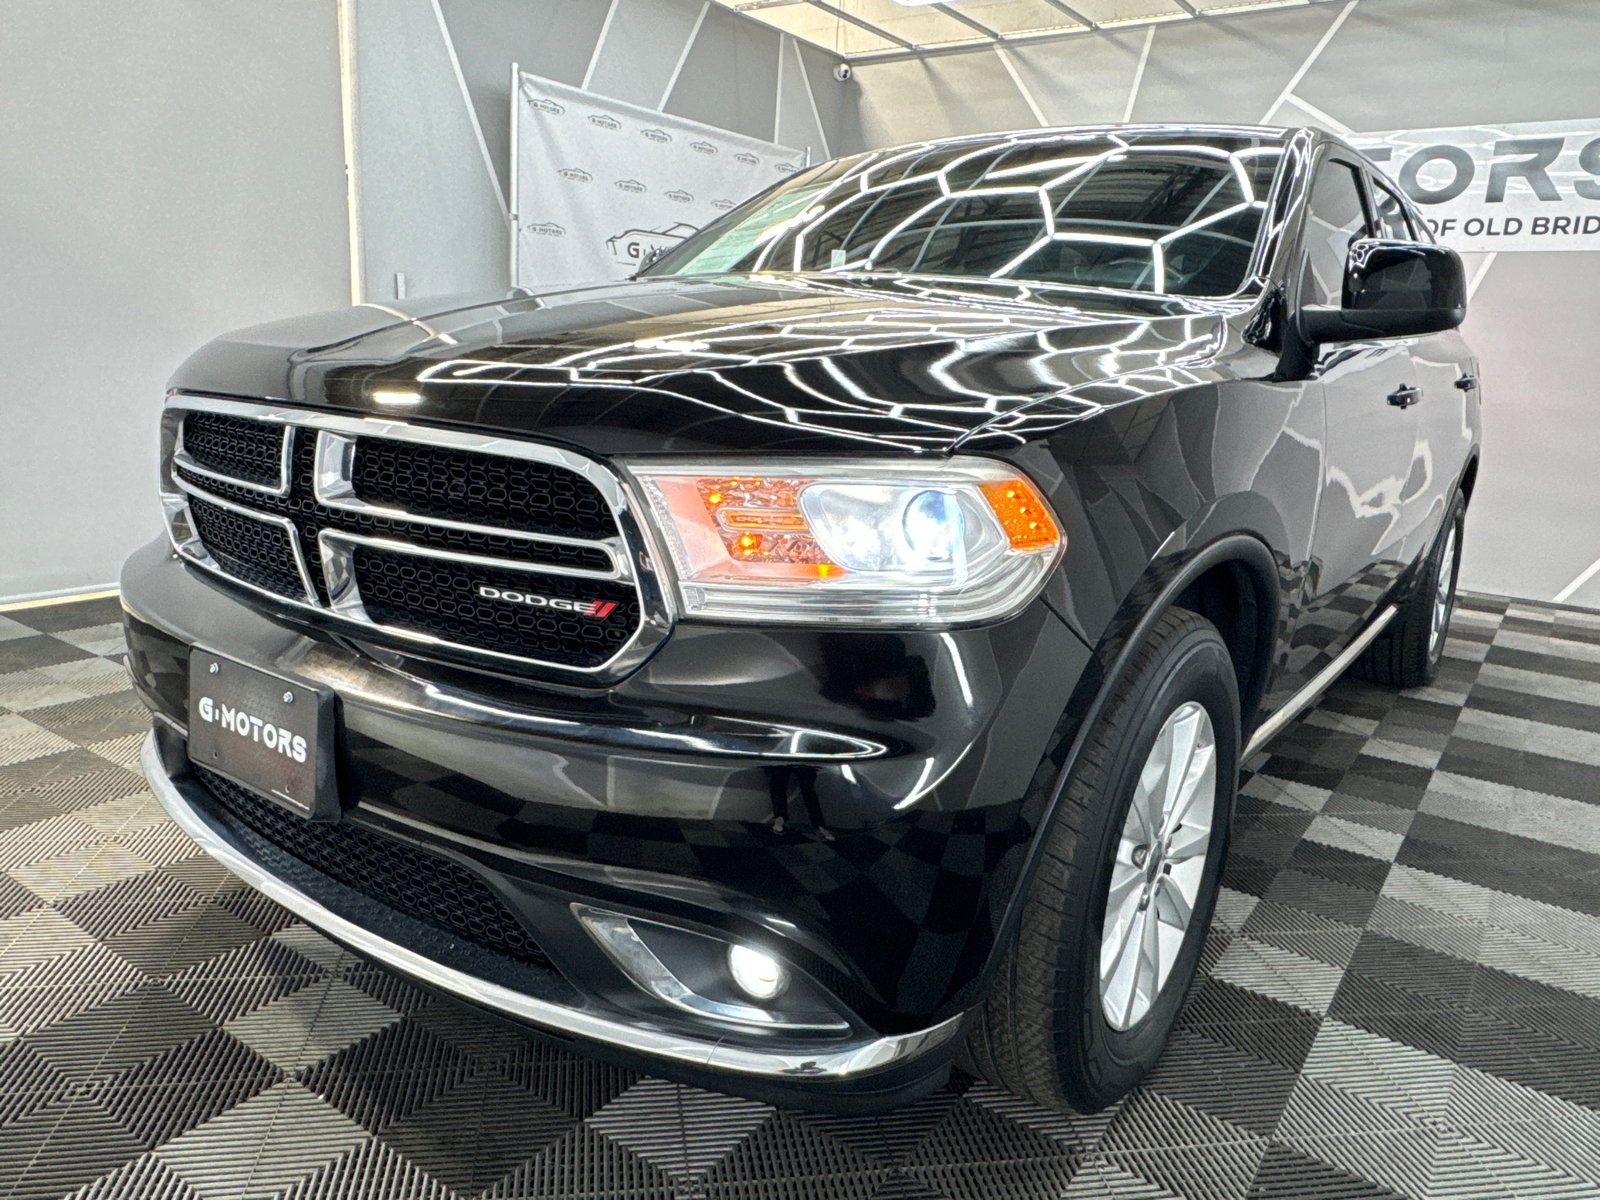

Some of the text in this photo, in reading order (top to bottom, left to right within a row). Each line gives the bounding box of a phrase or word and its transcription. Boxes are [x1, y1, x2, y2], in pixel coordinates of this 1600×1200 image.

[1463, 217, 1522, 236] OLD
[1530, 216, 1600, 236] BRID
[479, 586, 596, 615] DODGE
